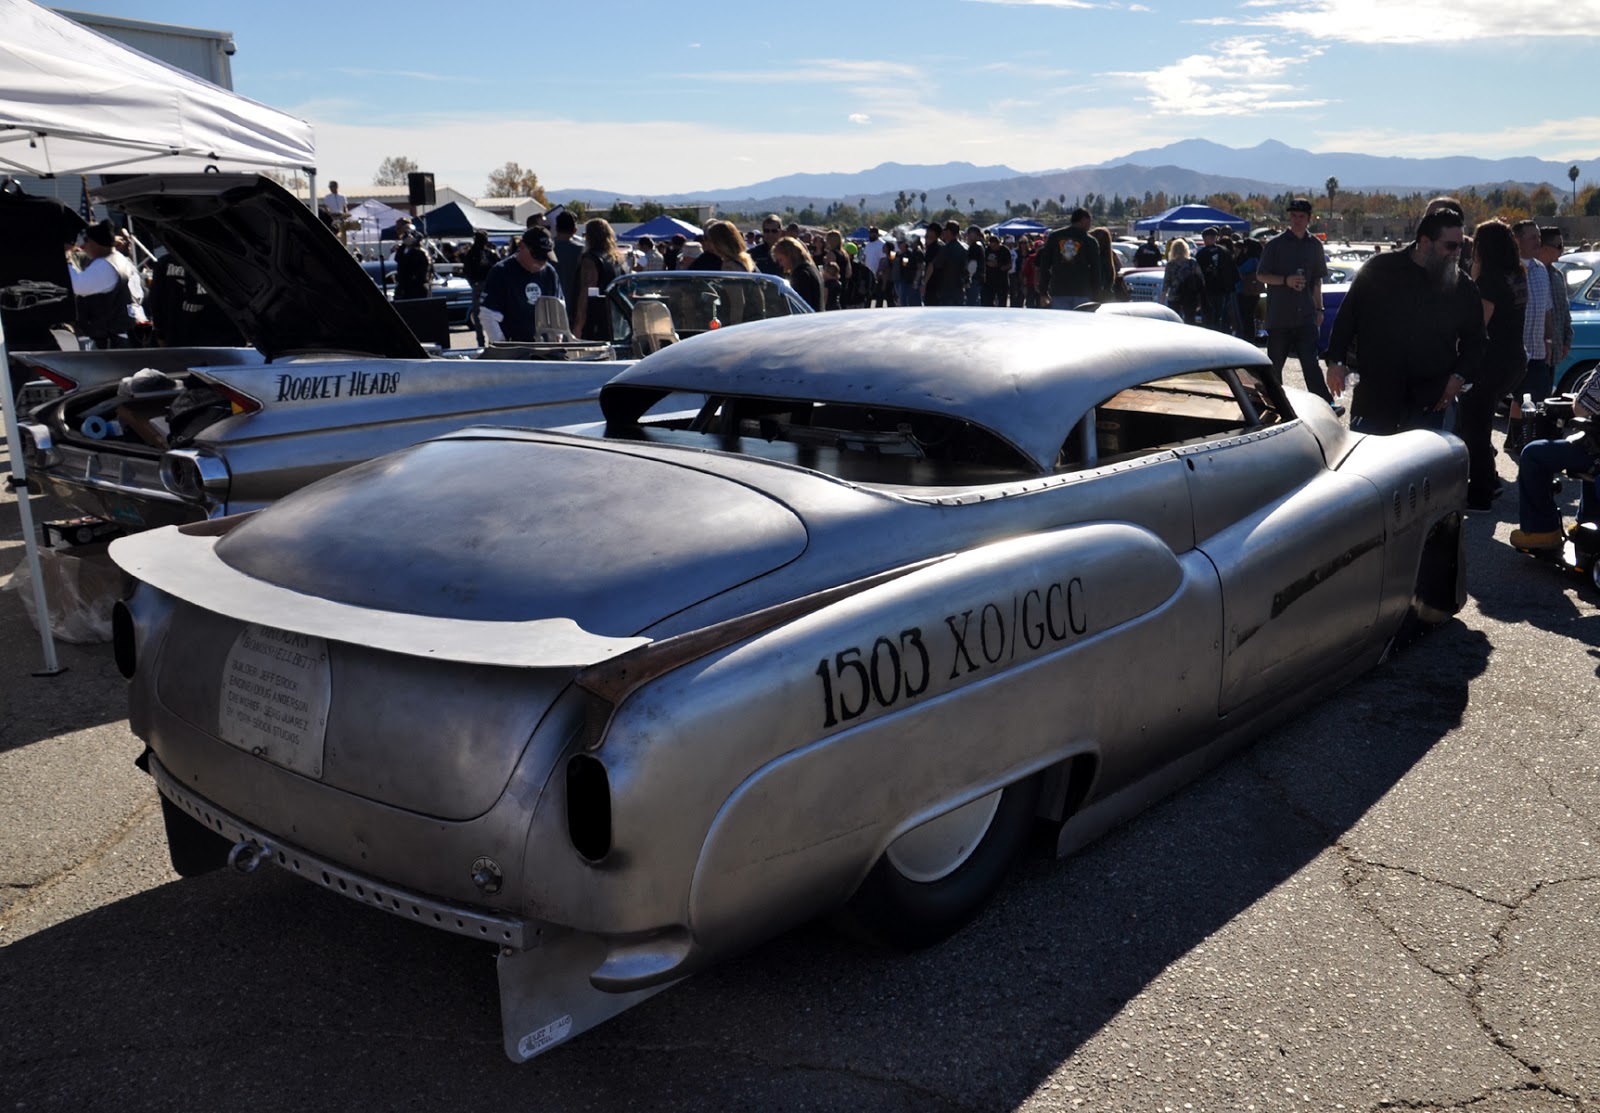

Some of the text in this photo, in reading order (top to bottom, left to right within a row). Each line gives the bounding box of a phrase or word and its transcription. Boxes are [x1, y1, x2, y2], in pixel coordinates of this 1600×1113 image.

[275, 371, 401, 402] ROCKET HEADS
[815, 577, 1087, 728] 1503 XO/GCC
[259, 669, 275, 683] JEFF
[276, 674, 298, 692] BROCK
[253, 684, 272, 698] DOUG
[272, 691, 309, 713] ANDERSON
[281, 712, 309, 731] JUAREZ
[272, 726, 300, 745] STUDIOS
